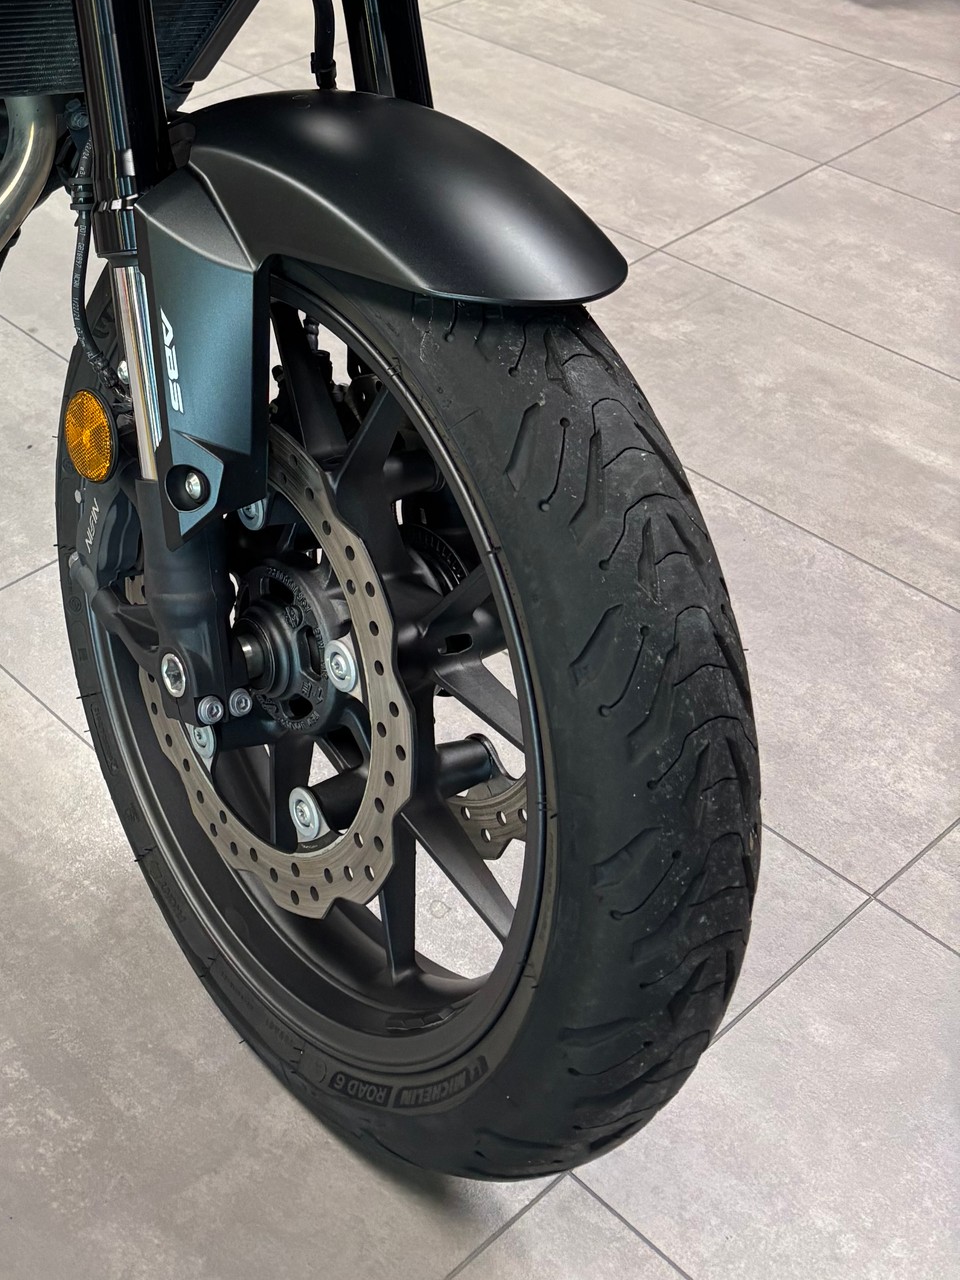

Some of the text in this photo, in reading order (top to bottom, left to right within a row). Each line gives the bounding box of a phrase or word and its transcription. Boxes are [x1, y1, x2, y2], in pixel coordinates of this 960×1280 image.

[160, 308, 184, 414] ABS
[334, 1070, 467, 1106] MICHELIN ROAD 6
